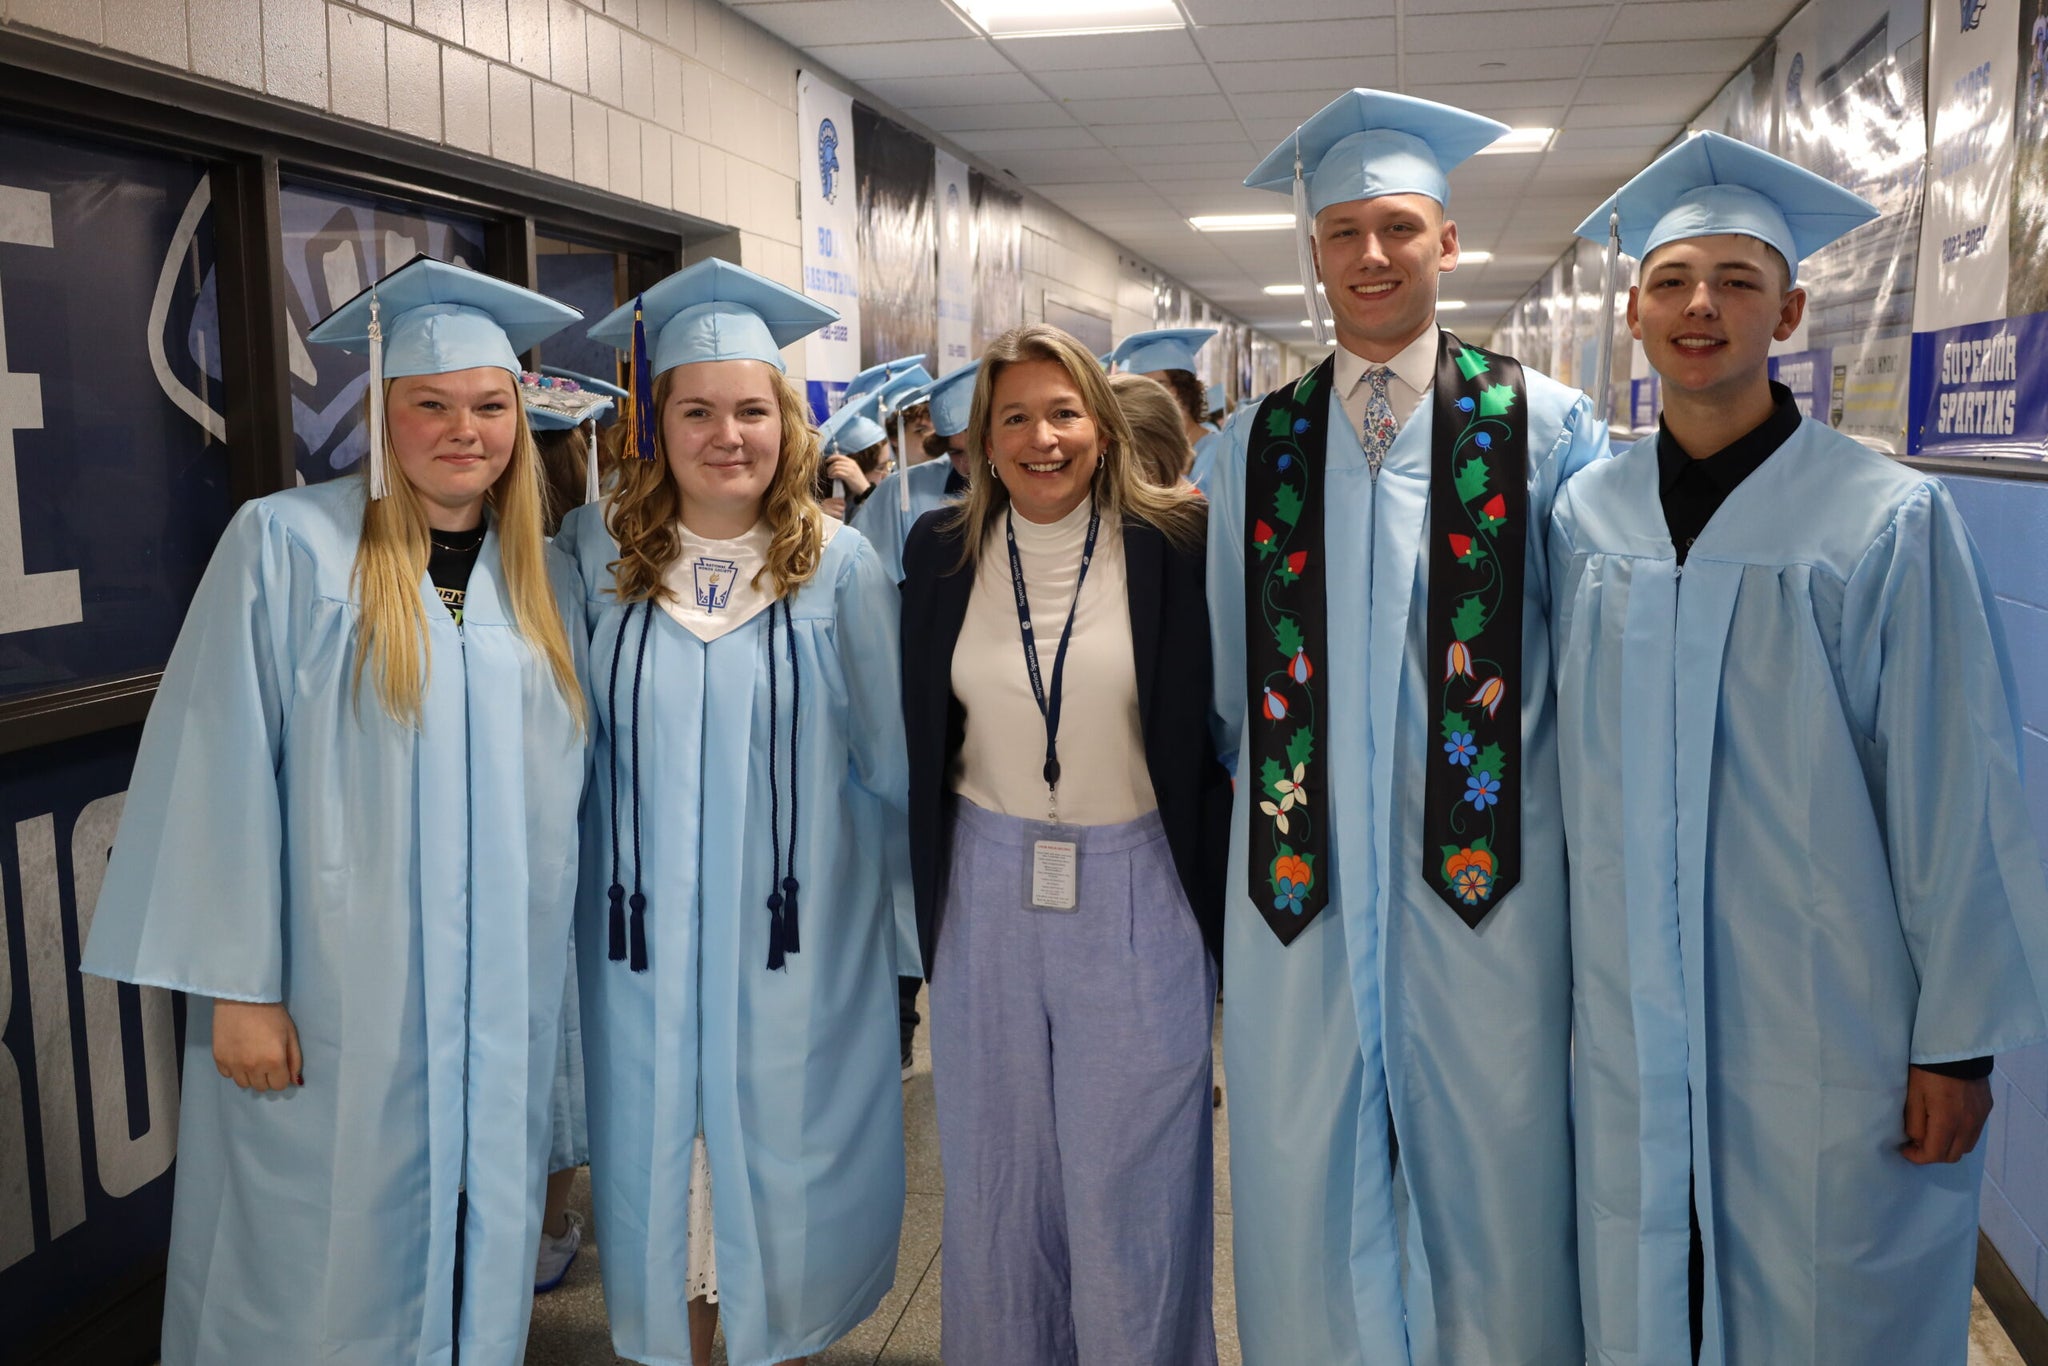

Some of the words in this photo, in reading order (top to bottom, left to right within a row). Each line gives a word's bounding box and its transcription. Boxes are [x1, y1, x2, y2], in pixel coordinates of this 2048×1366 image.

[1941, 335, 2017, 385] SUPERIOR
[1938, 390, 2016, 435] SPARTANS
[1032, 671, 1042, 700] Superior
